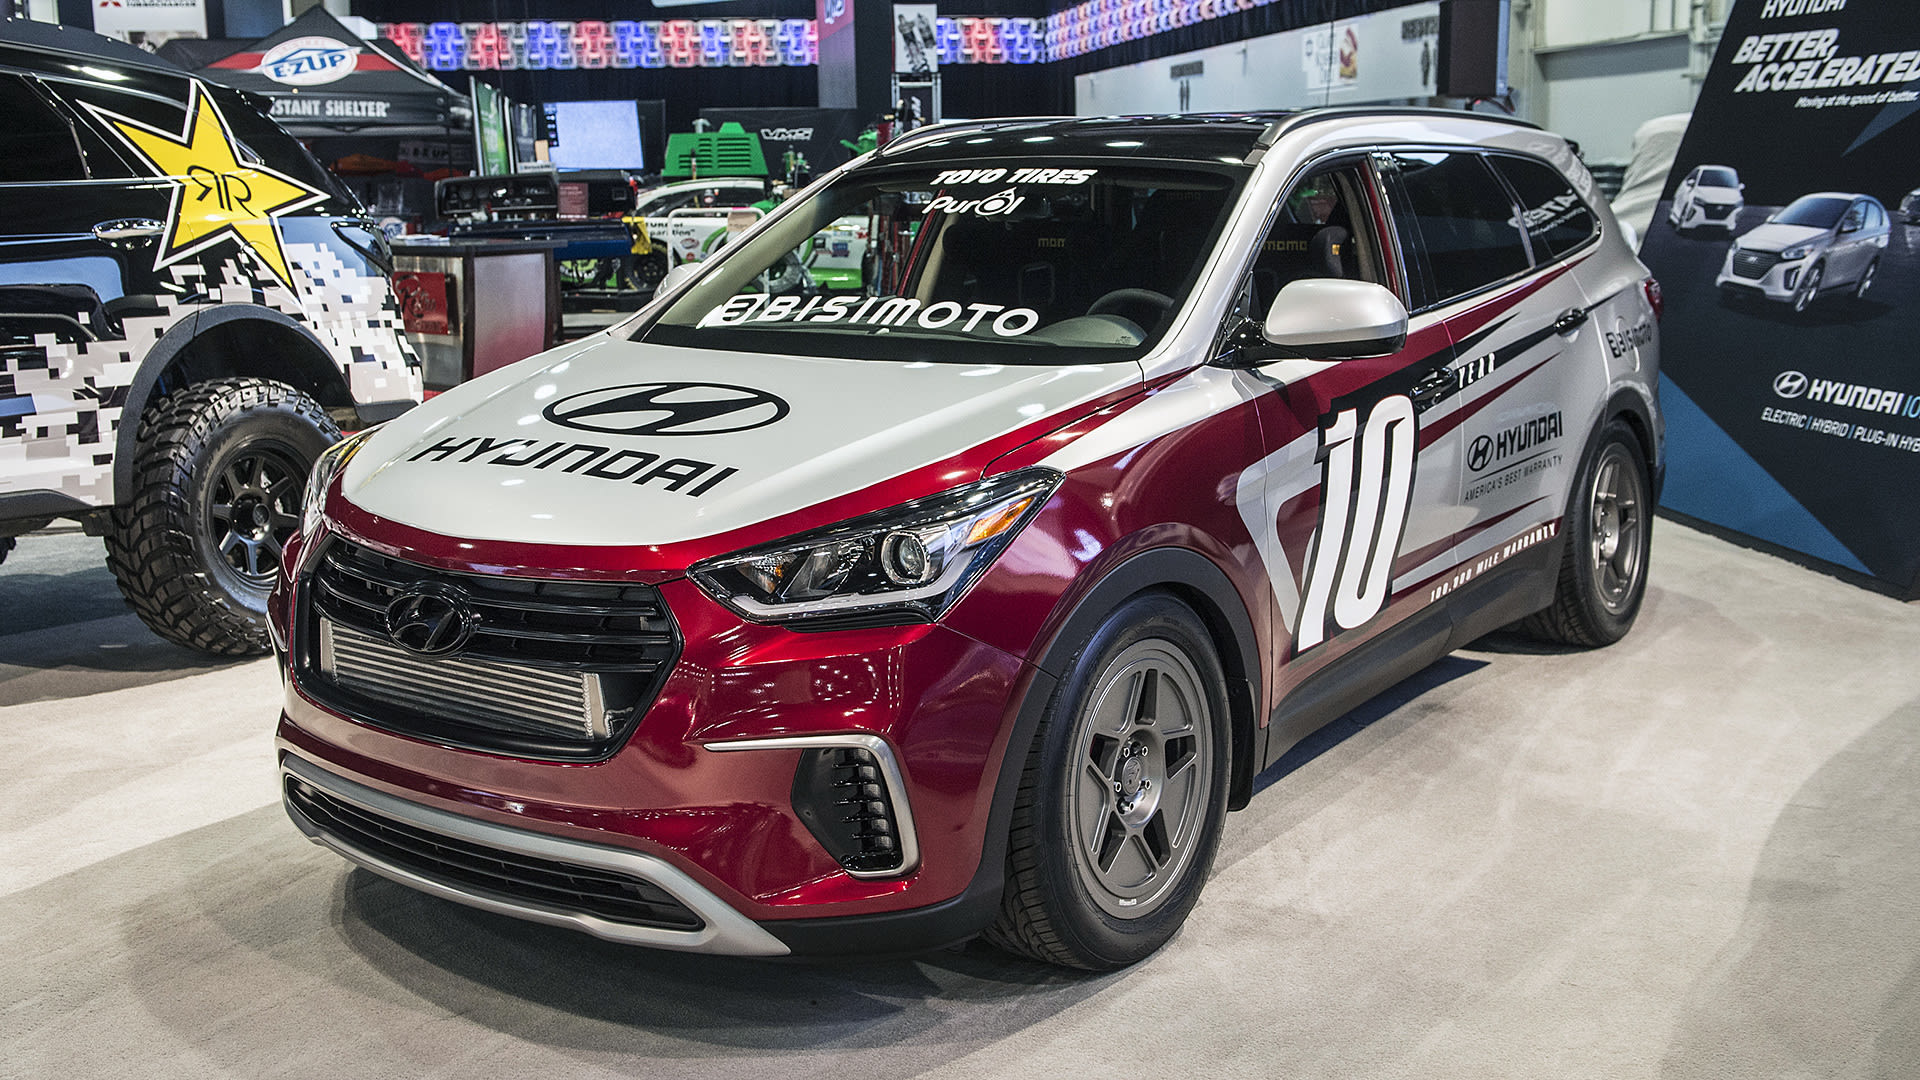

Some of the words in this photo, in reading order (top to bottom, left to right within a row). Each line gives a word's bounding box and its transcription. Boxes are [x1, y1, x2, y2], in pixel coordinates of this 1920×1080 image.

[1794, 96, 1827, 109] Moving
[1825, 96, 1837, 107] at
[1834, 95, 1851, 106] the
[1849, 91, 1881, 107] speed
[930, 168, 1008, 185] TOYO
[1005, 168, 1098, 185] TIRES
[1458, 352, 1496, 389] YEAR
[1807, 378, 1904, 415] HYUNDAI
[1496, 411, 1563, 460] HYUNDAI
[1760, 406, 1807, 429] ELECTRIC
[1810, 417, 1849, 438] HYBRID
[1853, 425, 1900, 448] PLUG-IN
[406, 436, 740, 498] HYUNDAI
[1464, 476, 1503, 503] AMERICA'S
[1504, 468, 1522, 487] BEST
[1523, 455, 1563, 477] WARRANTY
[1297, 394, 1415, 653] 10
[1475, 551, 1500, 575] MILE
[1503, 522, 1556, 559] WARRANTY
